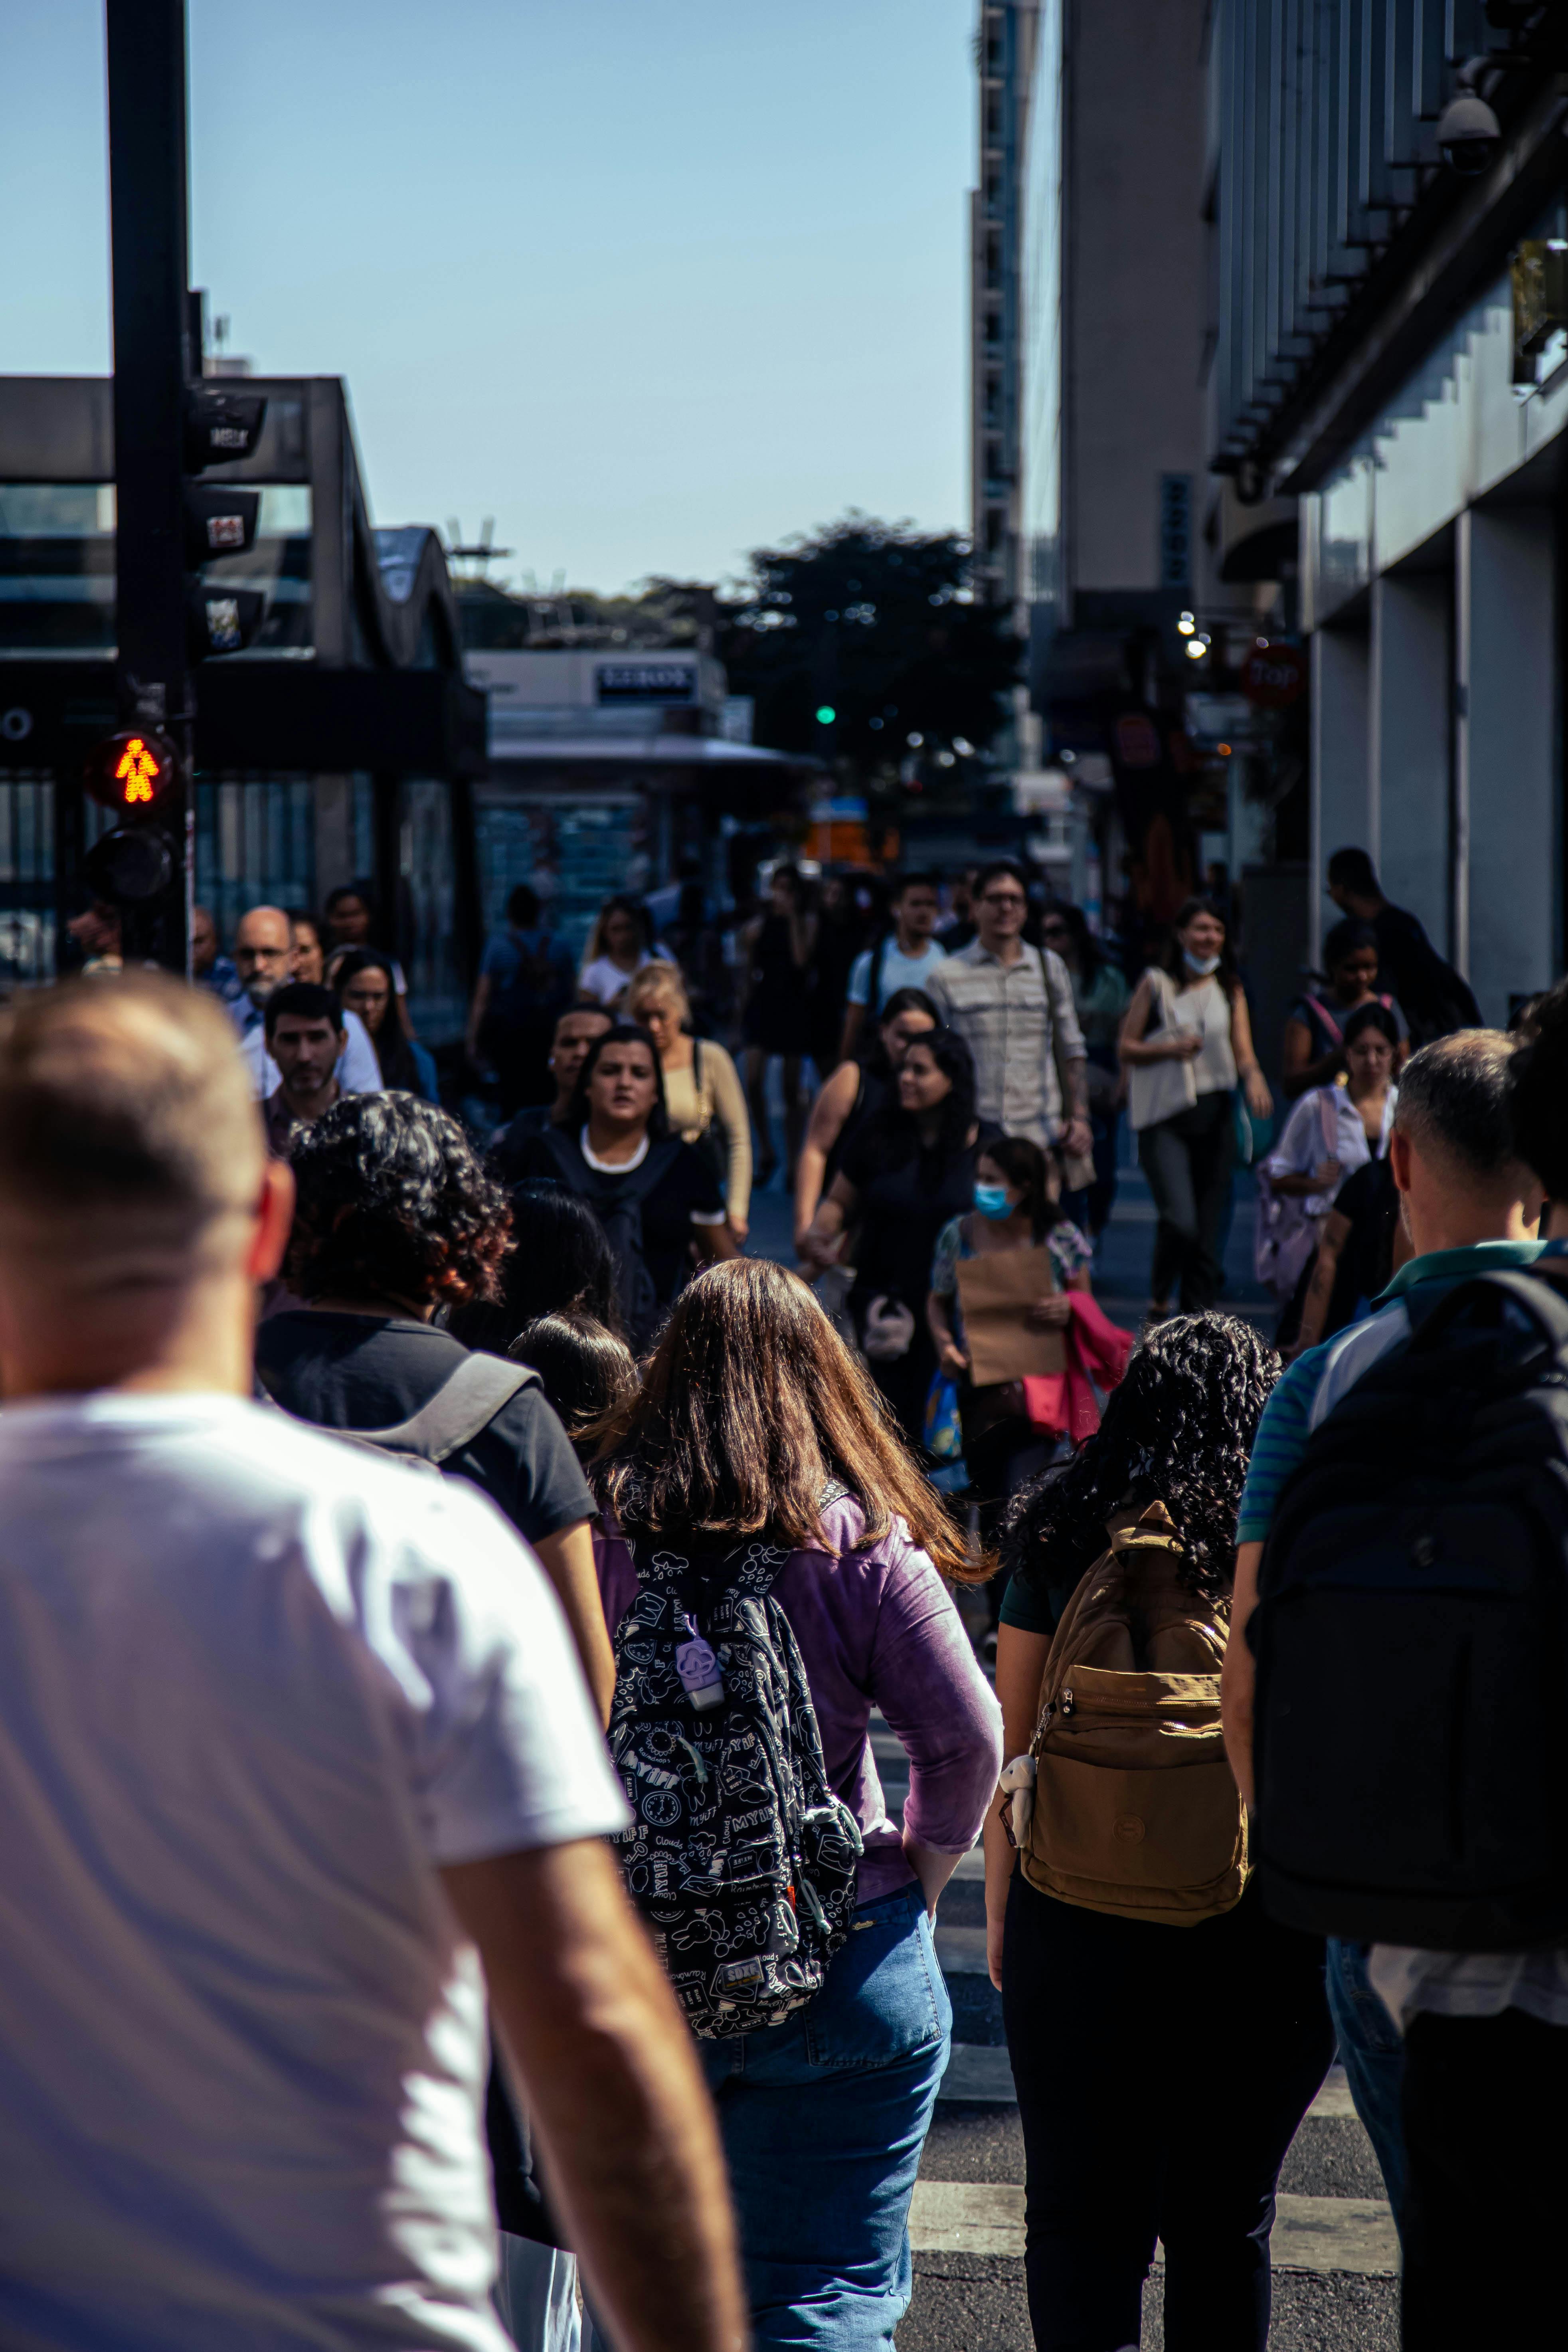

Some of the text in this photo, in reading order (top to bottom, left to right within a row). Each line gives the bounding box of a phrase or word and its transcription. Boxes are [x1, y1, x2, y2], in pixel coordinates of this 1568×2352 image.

[656, 1836, 684, 1850] Clouds
[649, 1891, 677, 1901] Cloud
[694, 1989, 702, 2003] BUSY
